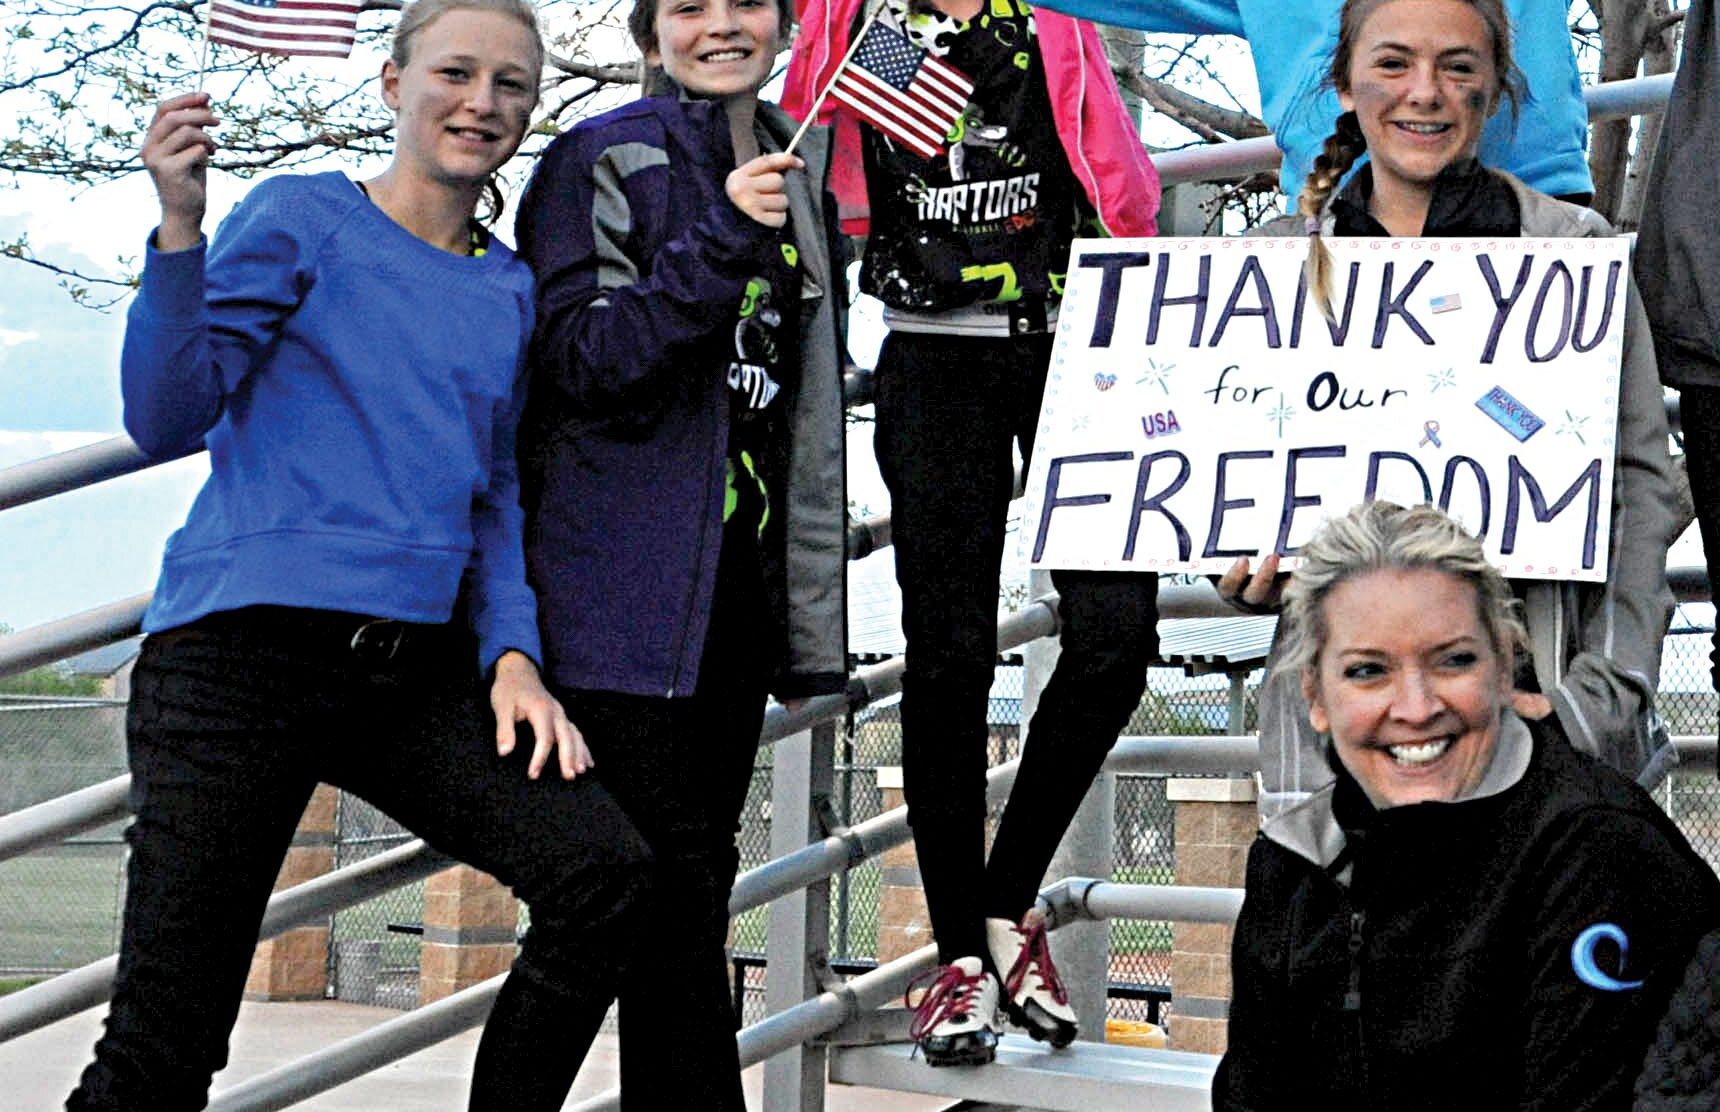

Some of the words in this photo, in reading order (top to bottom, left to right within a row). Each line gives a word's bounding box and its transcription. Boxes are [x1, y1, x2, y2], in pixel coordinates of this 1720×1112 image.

[917, 172, 1041, 225] RAPTORS
[1077, 251, 1436, 349] THANK
[1476, 252, 1622, 365] YOU
[1204, 364, 1273, 405] for
[1306, 370, 1408, 412] Our
[1141, 408, 1180, 437] USA
